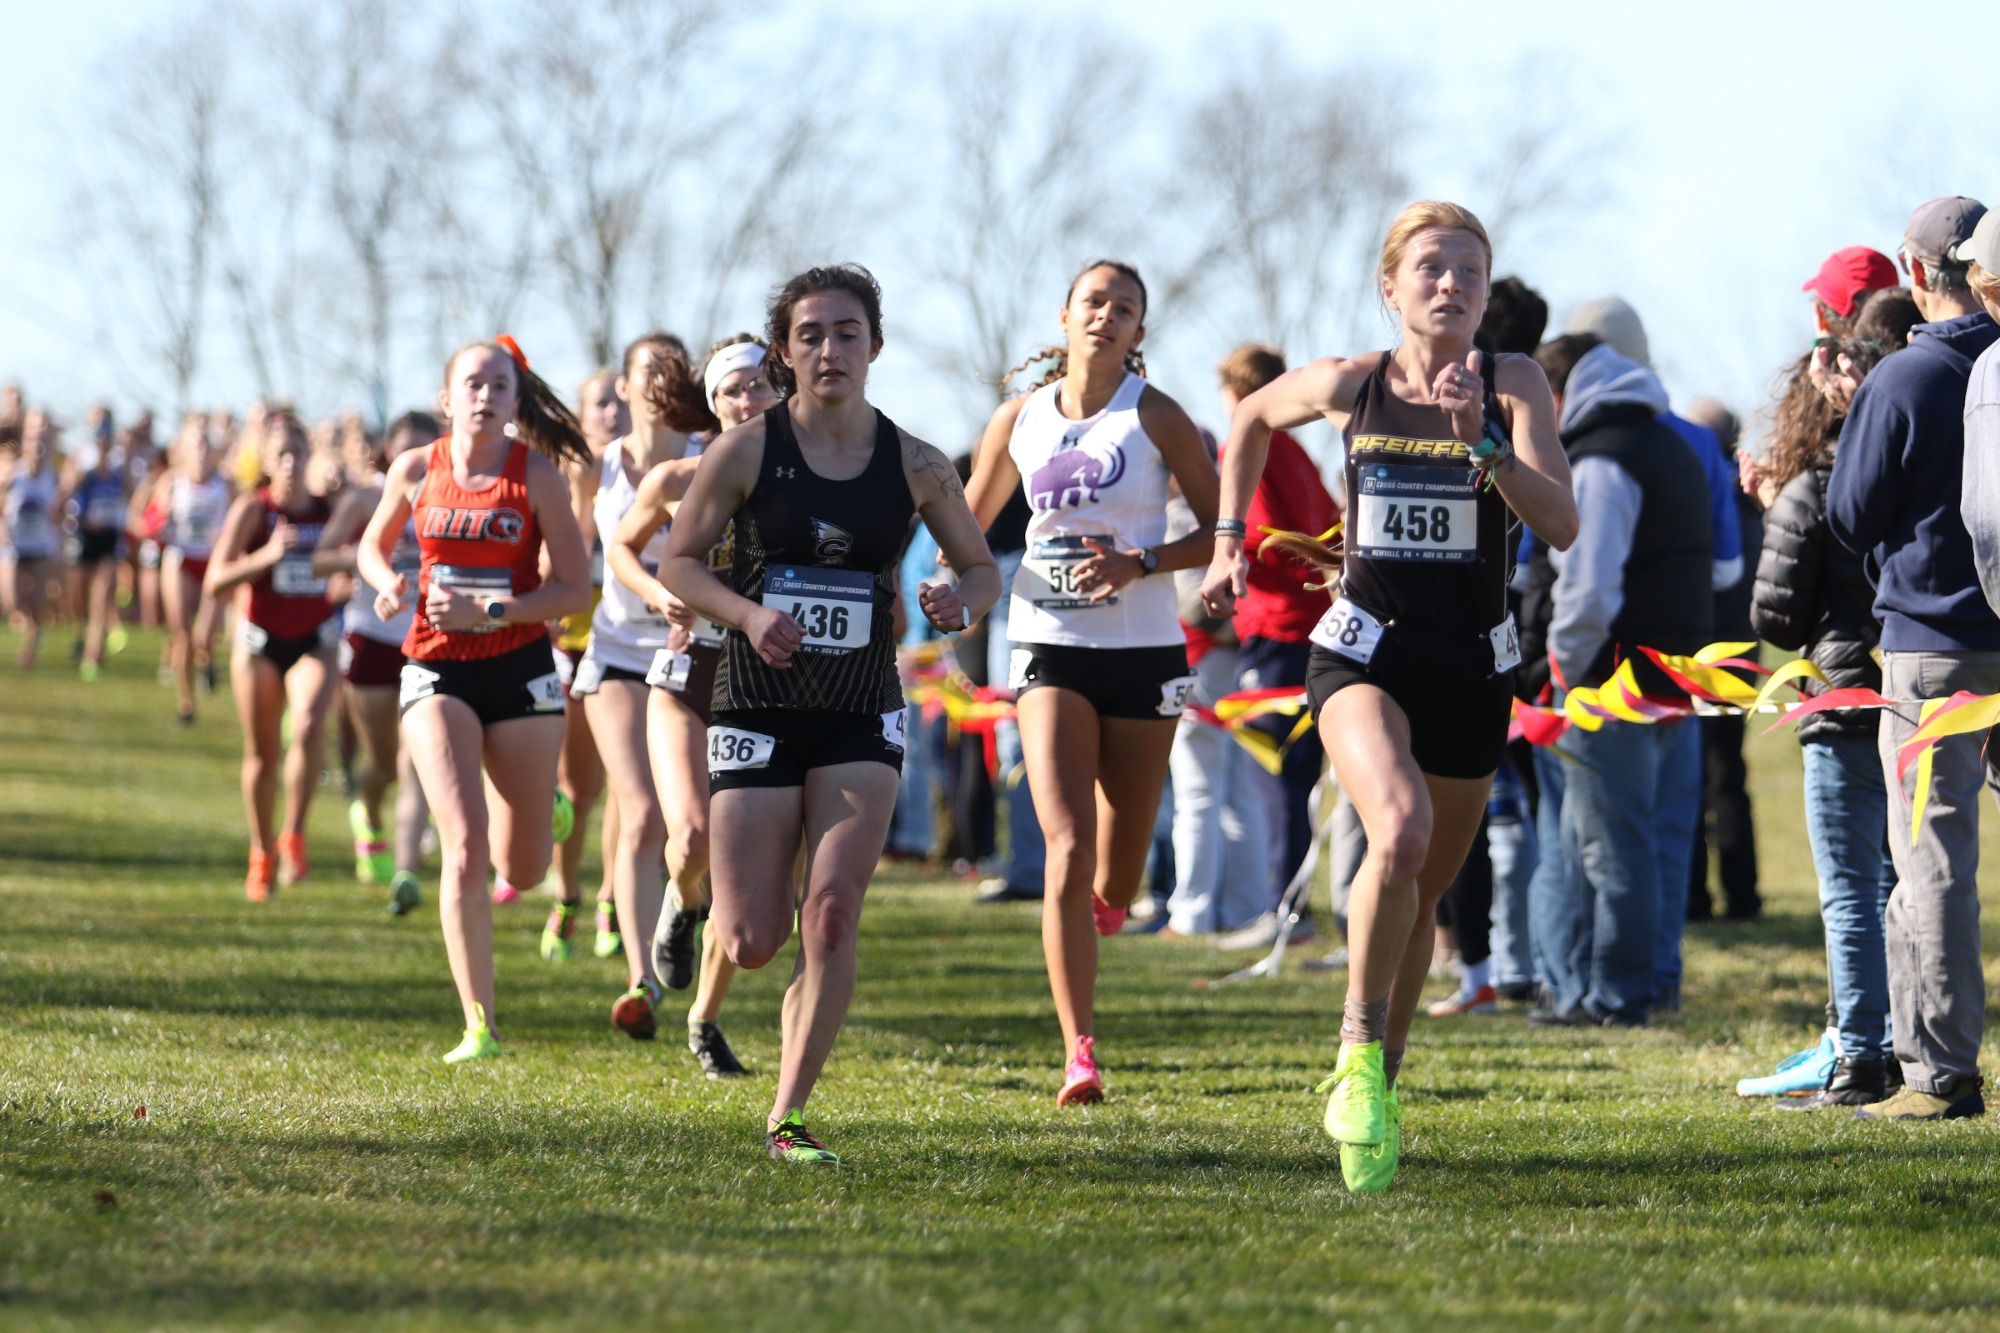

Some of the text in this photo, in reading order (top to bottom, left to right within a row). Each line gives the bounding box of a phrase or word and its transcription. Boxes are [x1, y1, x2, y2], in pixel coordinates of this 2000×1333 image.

[1350, 434, 1470, 458] PFEIFFE
[1376, 481, 1474, 492] CROSS COUNTRY CHAMPIONSHIPS
[422, 507, 493, 540] RIT
[1383, 504, 1450, 542] 458
[1371, 549, 1401, 558] NEWVILLE,
[1403, 550, 1412, 558] PA
[1423, 551, 1435, 559] NOV
[783, 581, 870, 595] CROSS COUNTRY CHAMPIONSHIPS
[791, 602, 849, 640] 436
[1320, 607, 1363, 647] 58
[711, 733, 756, 762] 436
